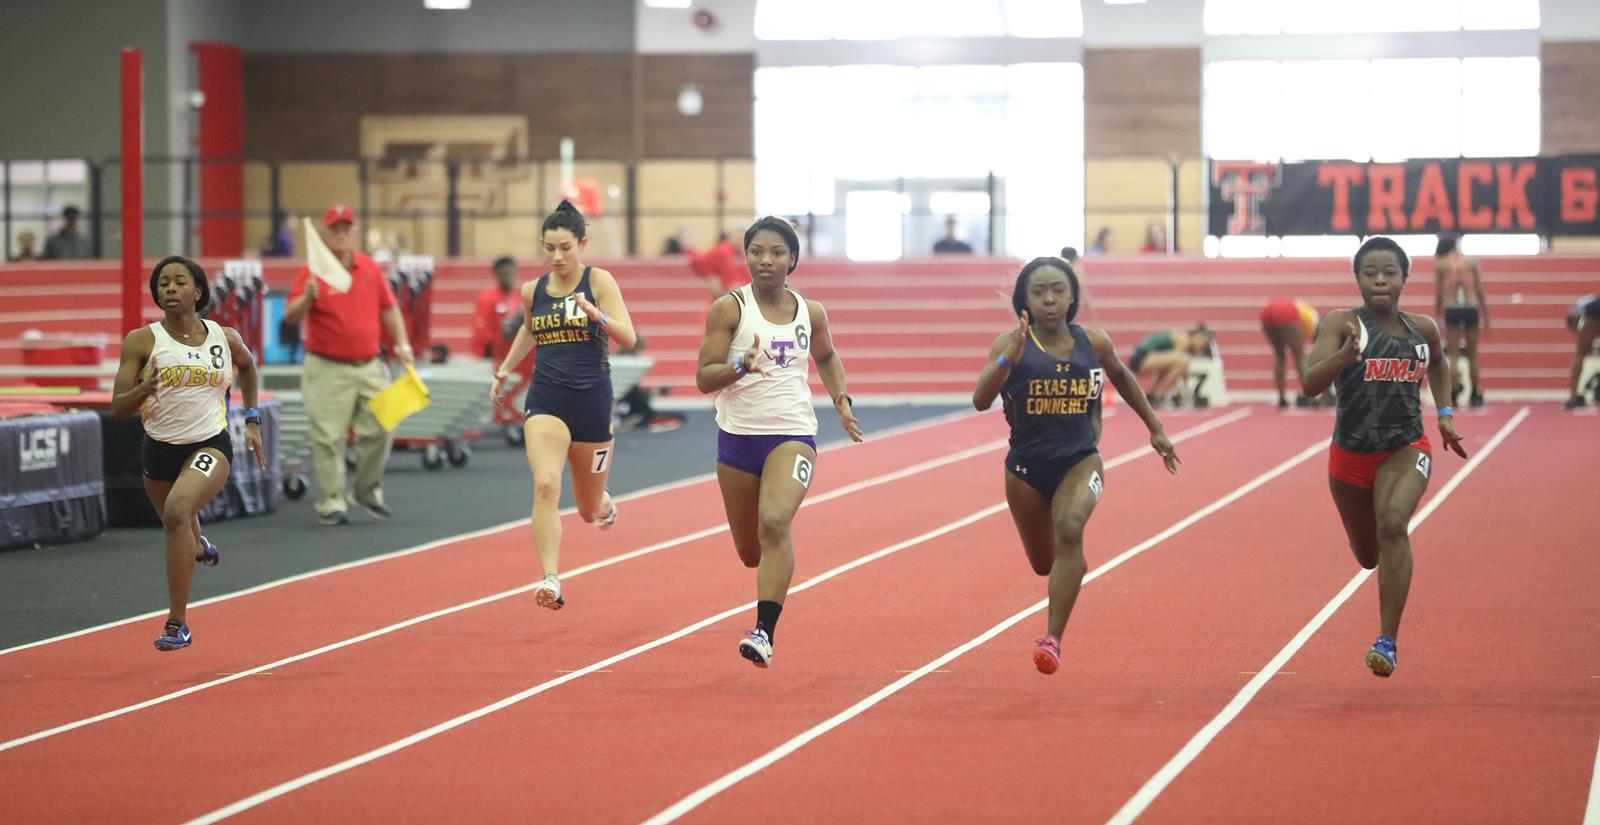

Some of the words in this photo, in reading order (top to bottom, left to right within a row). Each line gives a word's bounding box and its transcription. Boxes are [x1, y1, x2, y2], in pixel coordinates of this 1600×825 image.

[1317, 162, 1537, 231] TRACK
[532, 313, 561, 332] TEXAS
[795, 324, 808, 350] 6
[209, 344, 225, 369] 8
[159, 365, 225, 388] WBU
[1028, 378, 1068, 396] TEXAS
[1090, 371, 1102, 397] 5
[20, 428, 58, 461] UCS
[194, 454, 213, 473] 8
[596, 450, 608, 472] 7
[797, 460, 810, 484] 6
